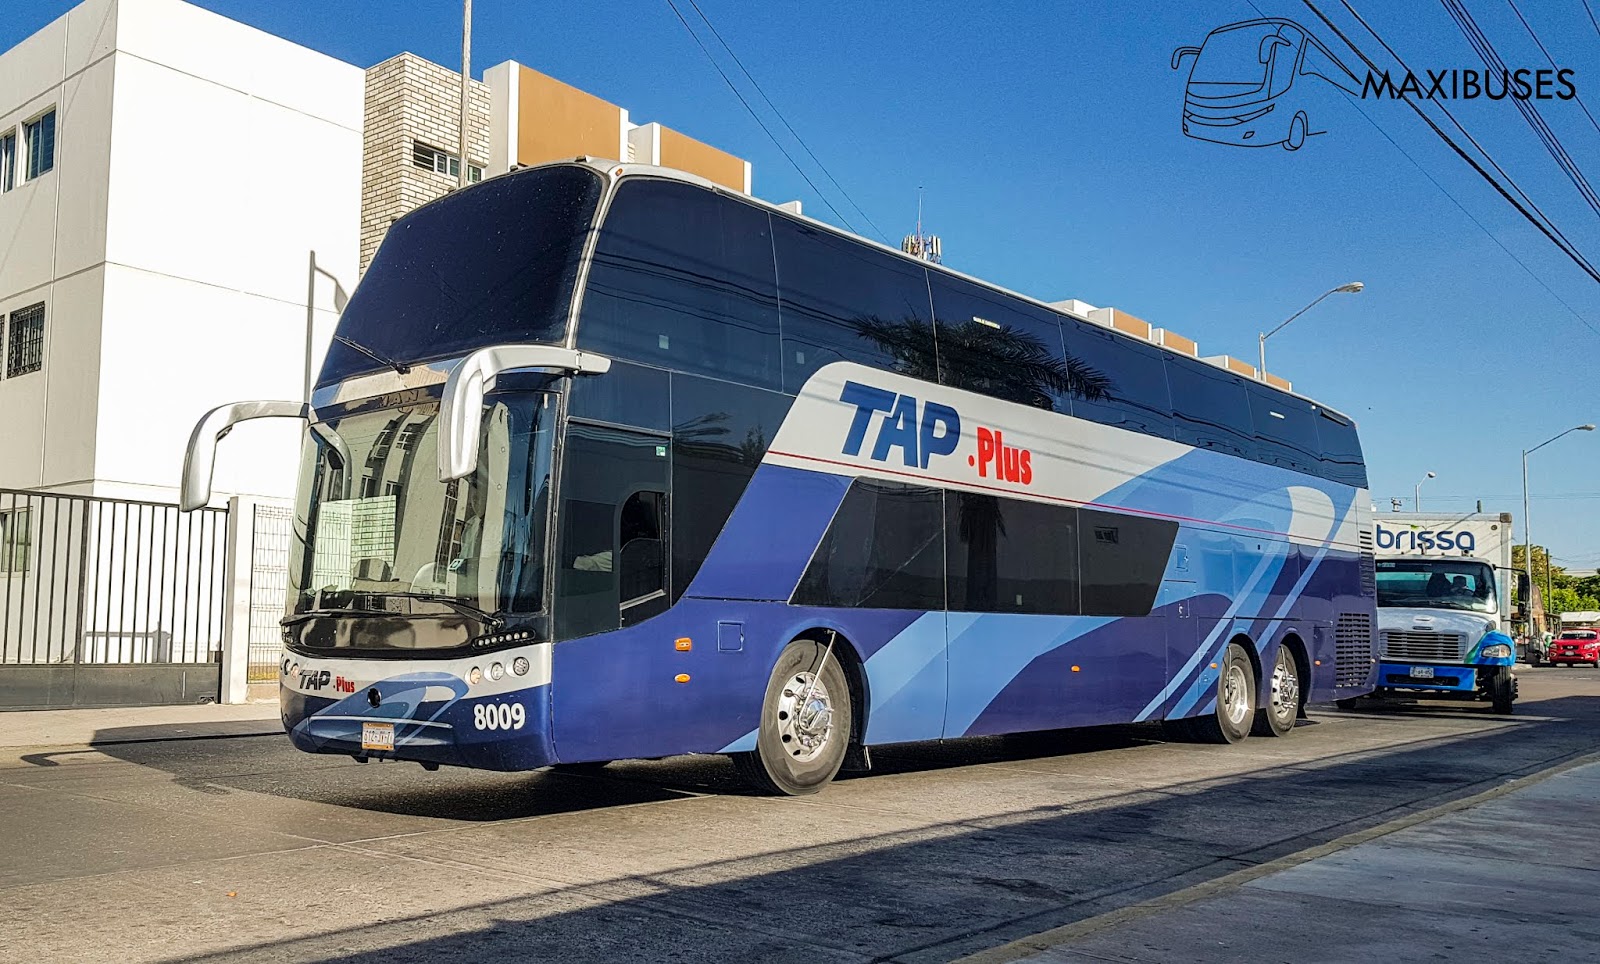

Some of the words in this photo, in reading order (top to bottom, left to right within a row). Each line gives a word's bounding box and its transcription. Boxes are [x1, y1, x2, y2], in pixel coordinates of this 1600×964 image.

[839, 380, 961, 470] TAP
[1376, 523, 1475, 551] brissa
[299, 669, 331, 690] TAP
[474, 702, 526, 731] 8009
